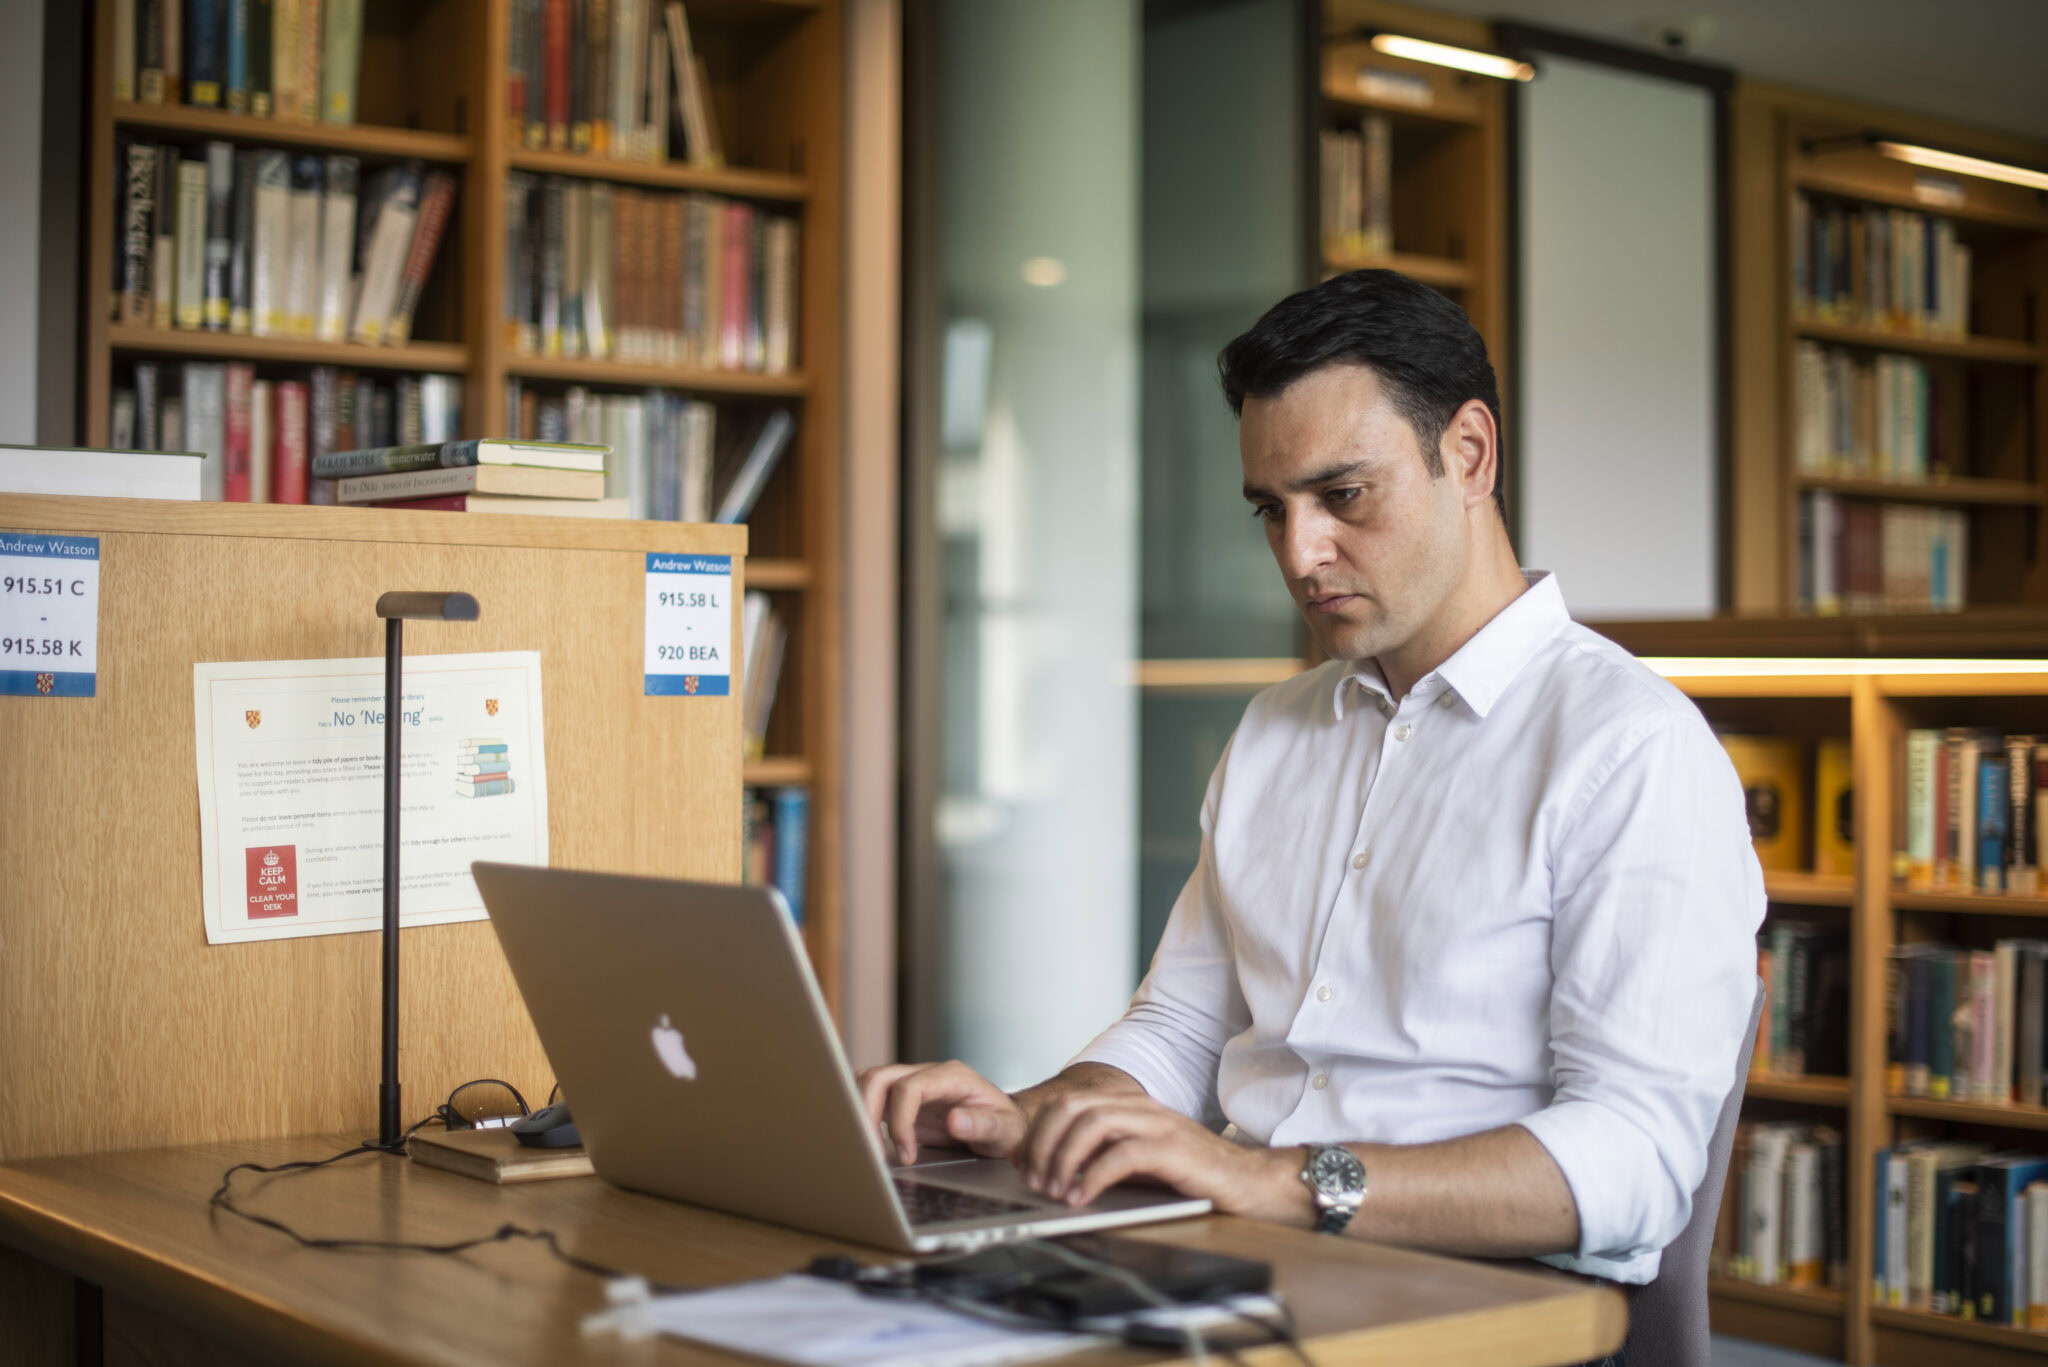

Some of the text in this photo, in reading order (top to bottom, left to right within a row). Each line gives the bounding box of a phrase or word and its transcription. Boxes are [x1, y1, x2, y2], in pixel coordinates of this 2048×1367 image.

[315, 455, 348, 469] SARAH
[349, 453, 375, 467] MOSS
[382, 451, 437, 465] Summerwater
[0, 538, 96, 556] Andrew Watson
[652, 558, 731, 573] Andrew Watson
[4, 576, 85, 596] 915.51 C
[659, 592, 720, 608] 915.58 L
[2, 637, 83, 657] 915.58 K
[658, 645, 720, 661] 920 BEA
[331, 696, 349, 704] Please
[352, 695, 381, 703] remember
[333, 711, 355, 727] No
[312, 758, 322, 766] tidy
[323, 757, 333, 765] pile
[340, 756, 358, 764] papers
[293, 812, 316, 820] personal
[410, 839, 421, 847] tidy
[421, 837, 441, 847] enough
[441, 836, 451, 844] for
[451, 835, 467, 844] others
[261, 866, 284, 876] KEEP
[259, 875, 286, 886] CALM
[361, 887, 371, 896] any
[249, 892, 296, 904] CLEAR YOUR
[263, 903, 282, 911] DESK
